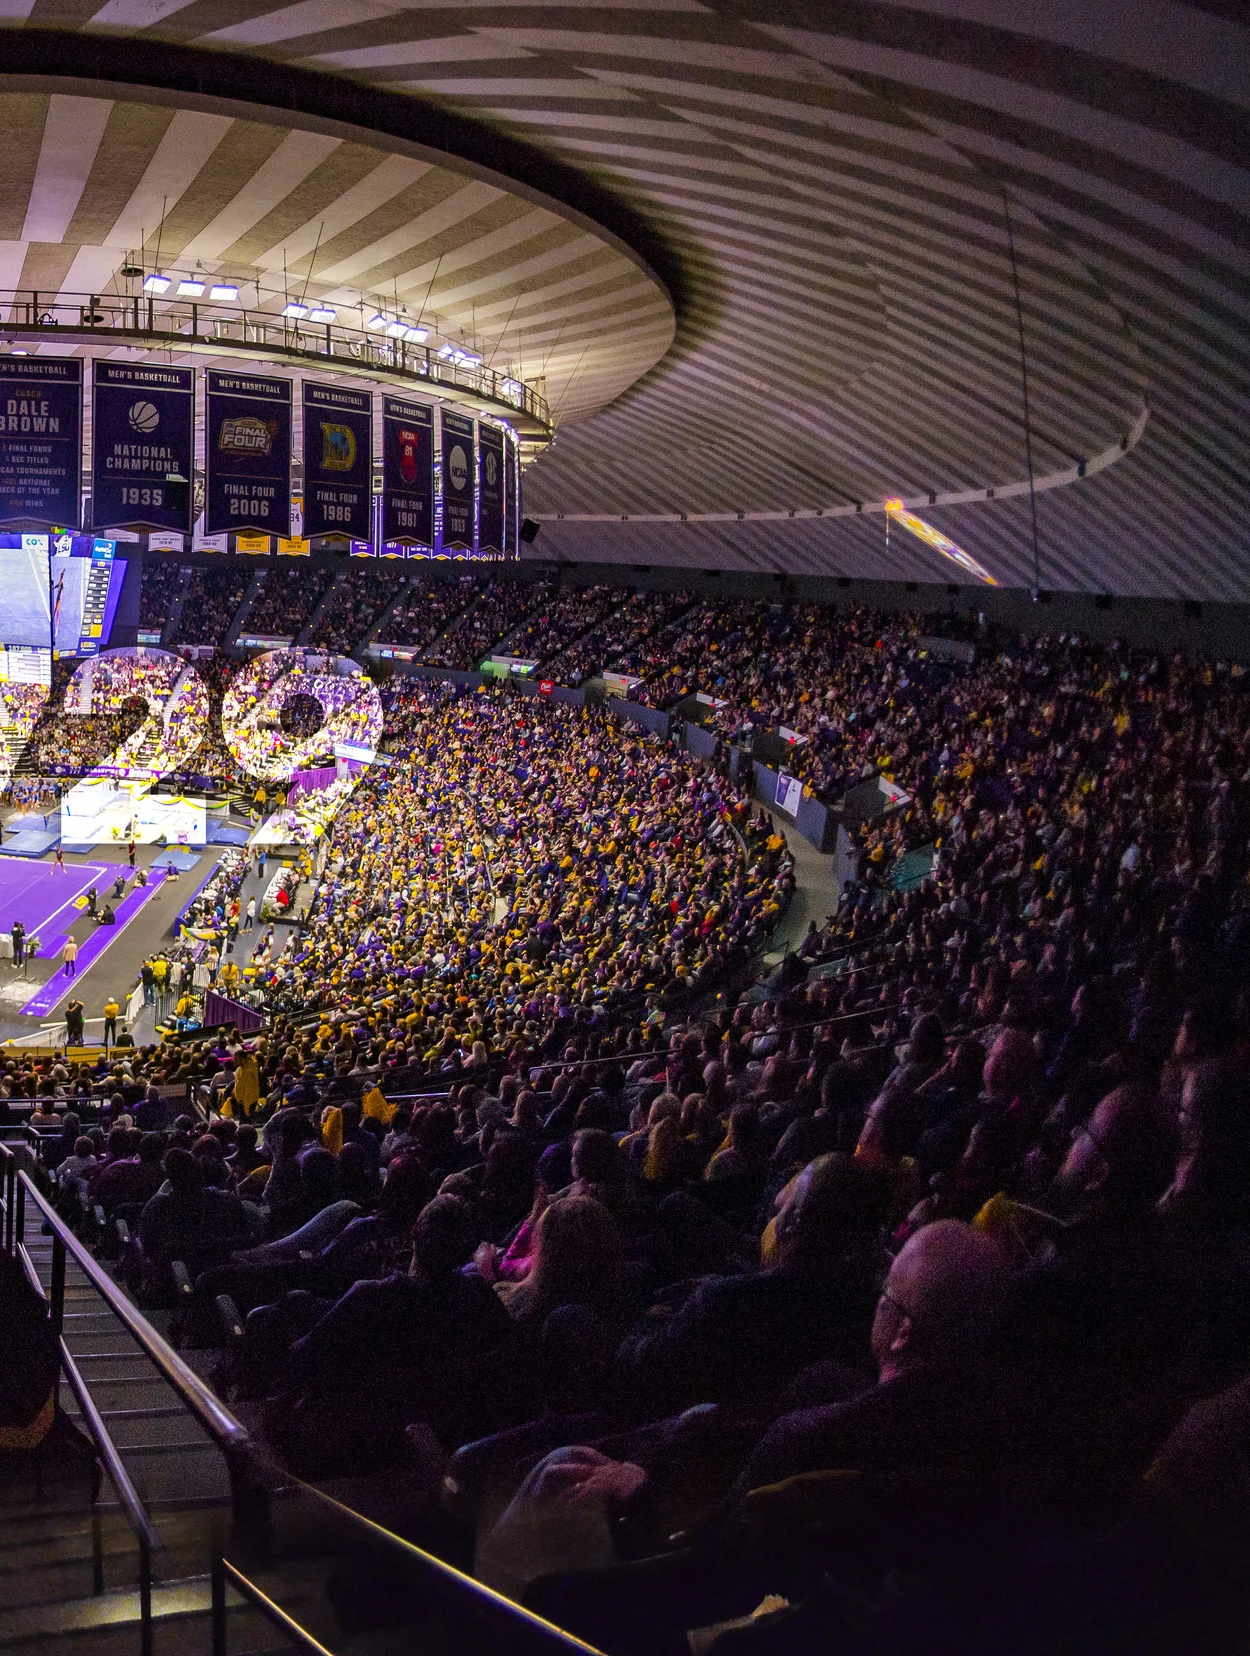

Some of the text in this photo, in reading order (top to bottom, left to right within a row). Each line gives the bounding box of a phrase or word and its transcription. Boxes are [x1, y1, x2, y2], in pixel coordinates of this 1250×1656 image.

[18, 365, 67, 375] BASKETBALL
[108, 369, 180, 384] MEN'S BASKETBALL
[219, 379, 280, 394] MEN'S BASKETBALL
[313, 390, 363, 406] MEN'S BASKETBALL
[7, 400, 49, 416] DALE
[403, 407, 426, 419] BASKETBALL
[235, 426, 266, 437] FINAL
[402, 431, 415, 441] NCAA
[223, 434, 266, 448] FOUR
[29, 445, 52, 453] FOURS
[114, 444, 173, 459] NATIONAL
[405, 445, 413, 457] 81
[106, 456, 179, 473] CHAMPIONS
[16, 468, 66, 476] TOURNAMENTS
[452, 467, 467, 479] NCAA
[19, 478, 50, 486] NATIONAL
[121, 487, 163, 506] 1935
[224, 484, 275, 497] FINAL FOUR
[25, 500, 43, 508] WINS
[317, 491, 358, 504] FINAL FOUR
[230, 498, 269, 516] 2006
[392, 498, 423, 511] FINAL FOUR
[323, 504, 351, 522] 1986
[397, 512, 417, 528] 1981
